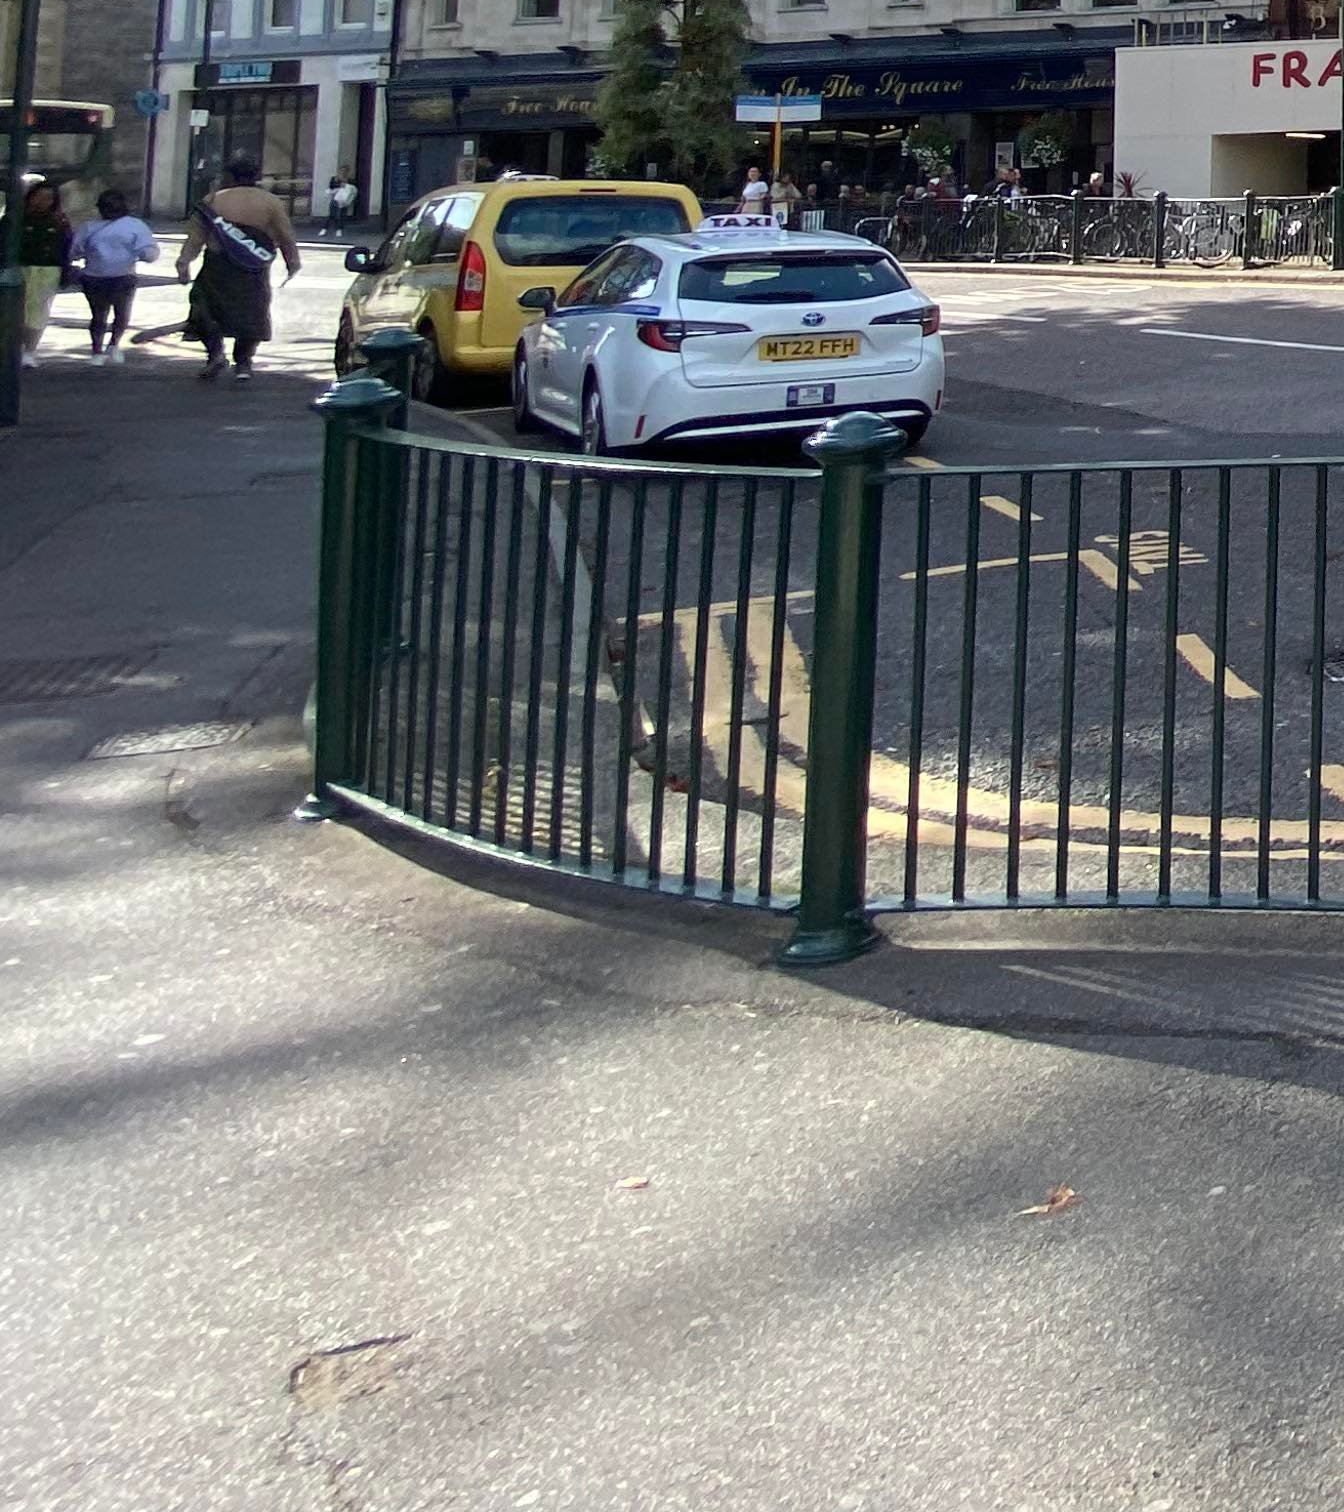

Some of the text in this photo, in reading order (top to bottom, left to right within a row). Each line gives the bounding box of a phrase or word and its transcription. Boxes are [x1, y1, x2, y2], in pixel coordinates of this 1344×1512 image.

[821, 74, 866, 99] The
[875, 71, 963, 105] Square
[711, 217, 772, 227] TAXI
[213, 216, 273, 260] HEAD
[766, 338, 854, 356] MT22 FFH
